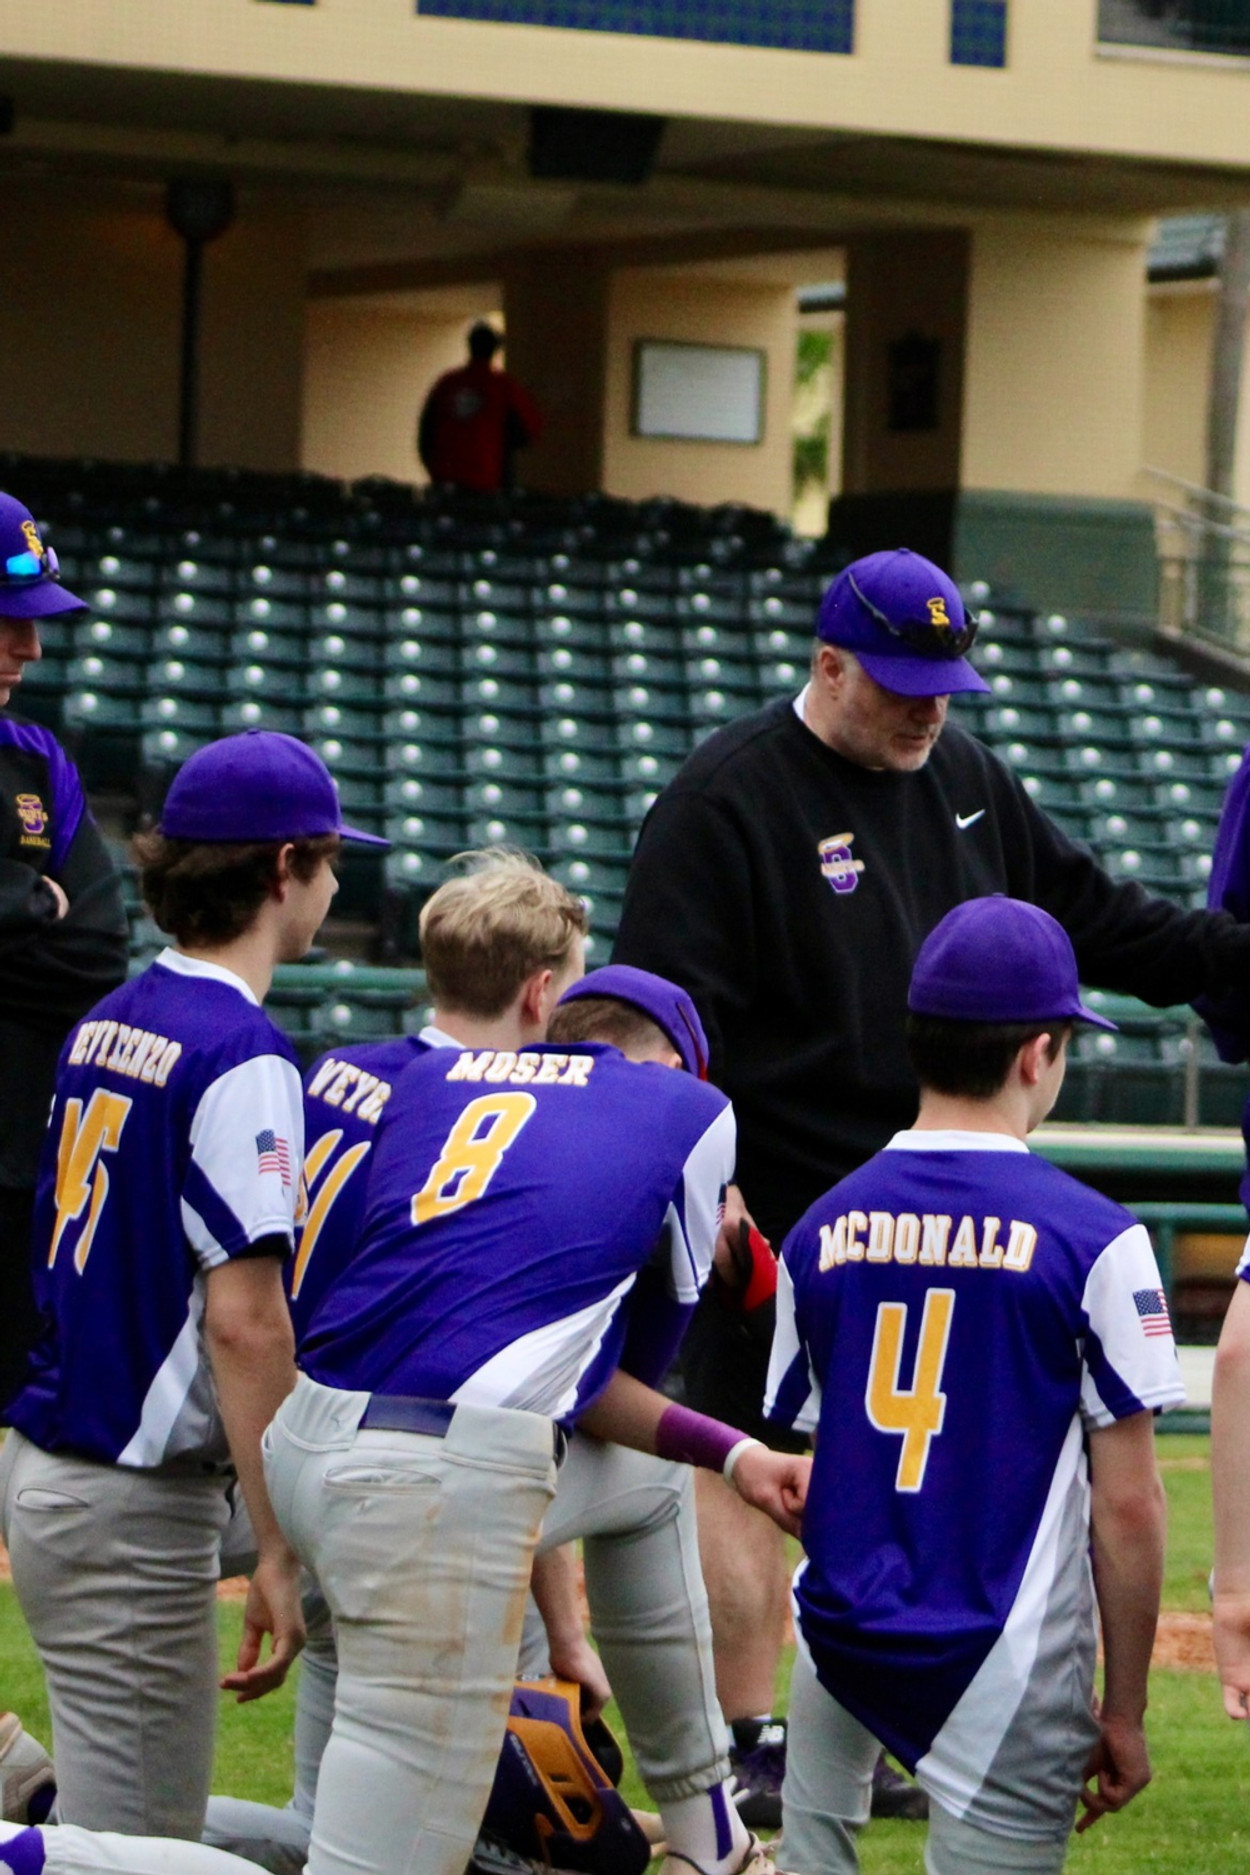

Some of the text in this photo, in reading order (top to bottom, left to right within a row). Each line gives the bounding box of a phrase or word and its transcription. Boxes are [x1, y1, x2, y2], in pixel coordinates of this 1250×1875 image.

[446, 1051, 594, 1086] MOSER
[410, 1091, 537, 1226] 8
[818, 1210, 1037, 1273] MCDONALD
[865, 1287, 955, 1493] 4
